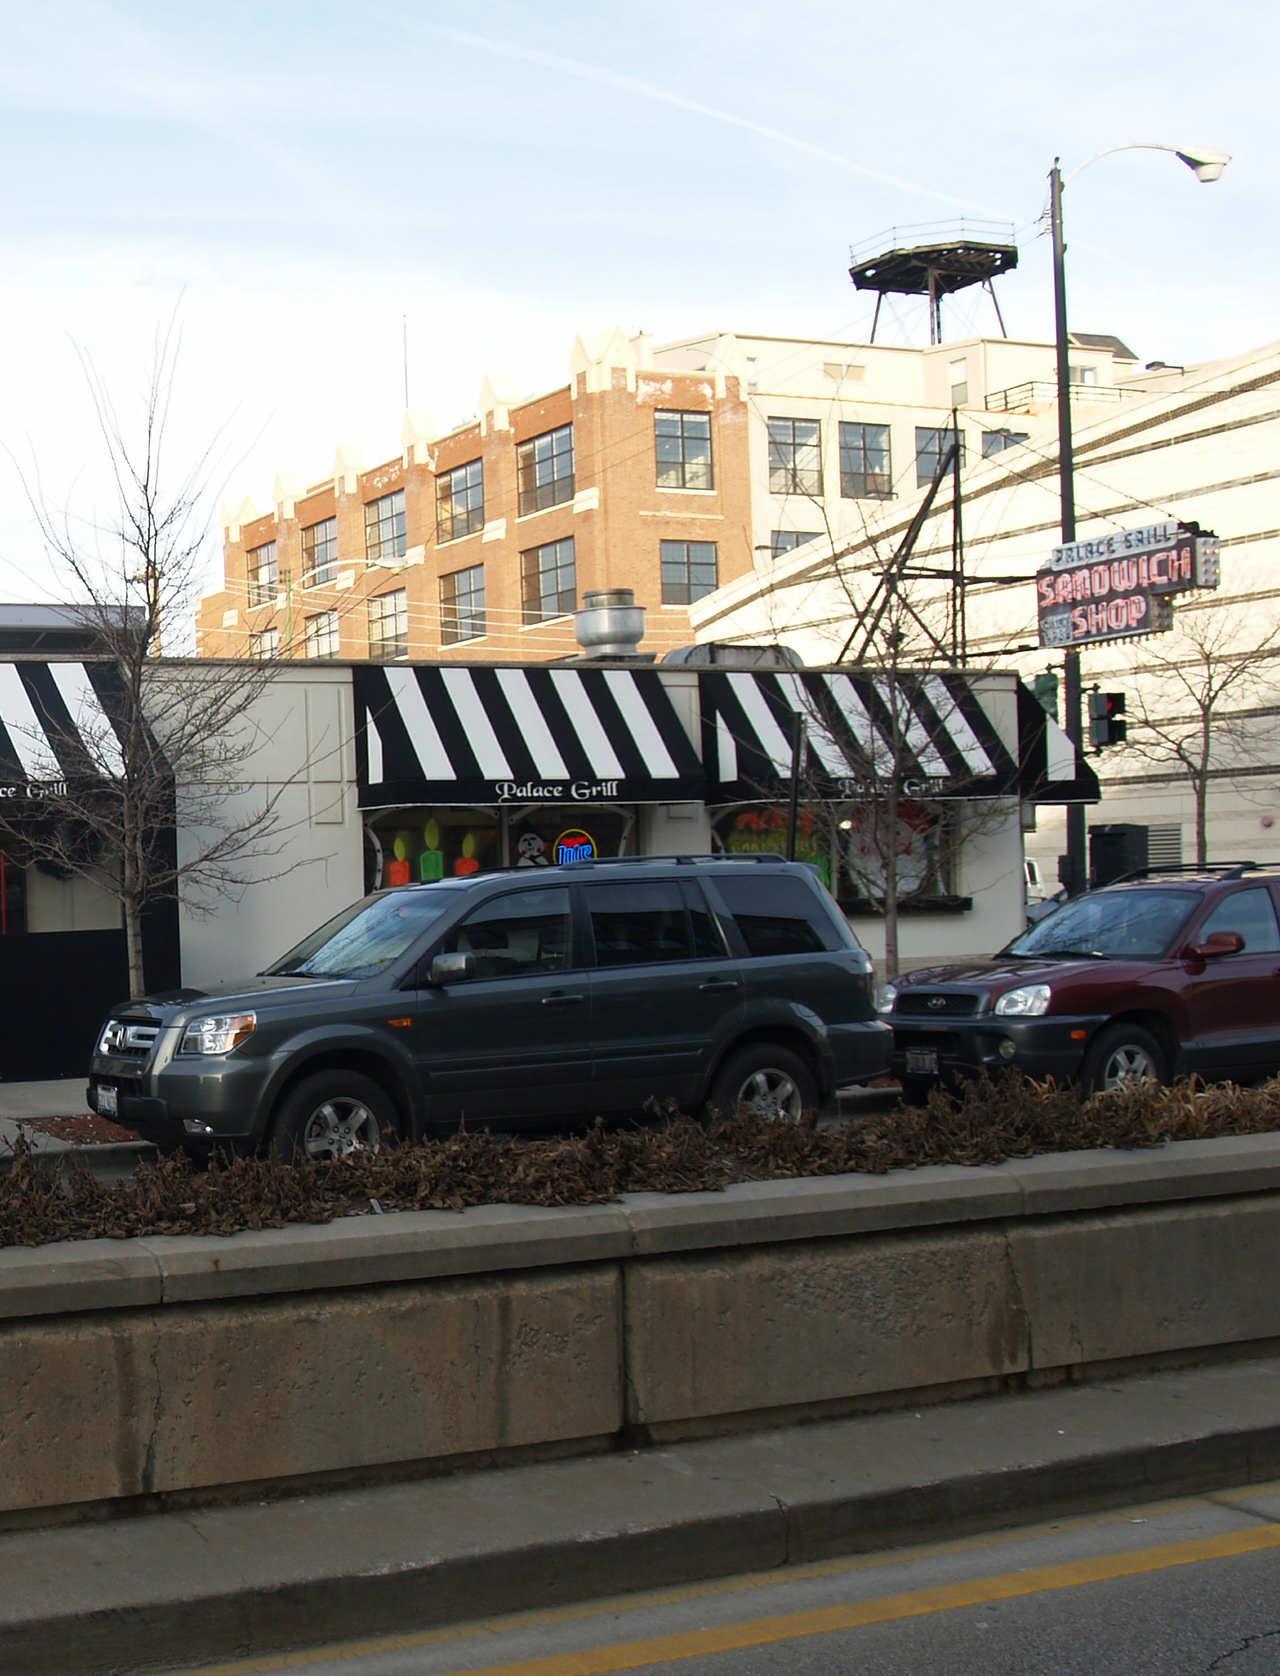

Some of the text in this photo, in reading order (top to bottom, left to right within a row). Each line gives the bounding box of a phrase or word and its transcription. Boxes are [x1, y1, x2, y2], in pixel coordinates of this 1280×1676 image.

[1054, 536, 1115, 564] PALACE
[1037, 546, 1191, 607] SANDWICH
[1071, 594, 1147, 637] SHOP
[495, 780, 619, 802] Palace Grill
[838, 779, 896, 799] Pac
